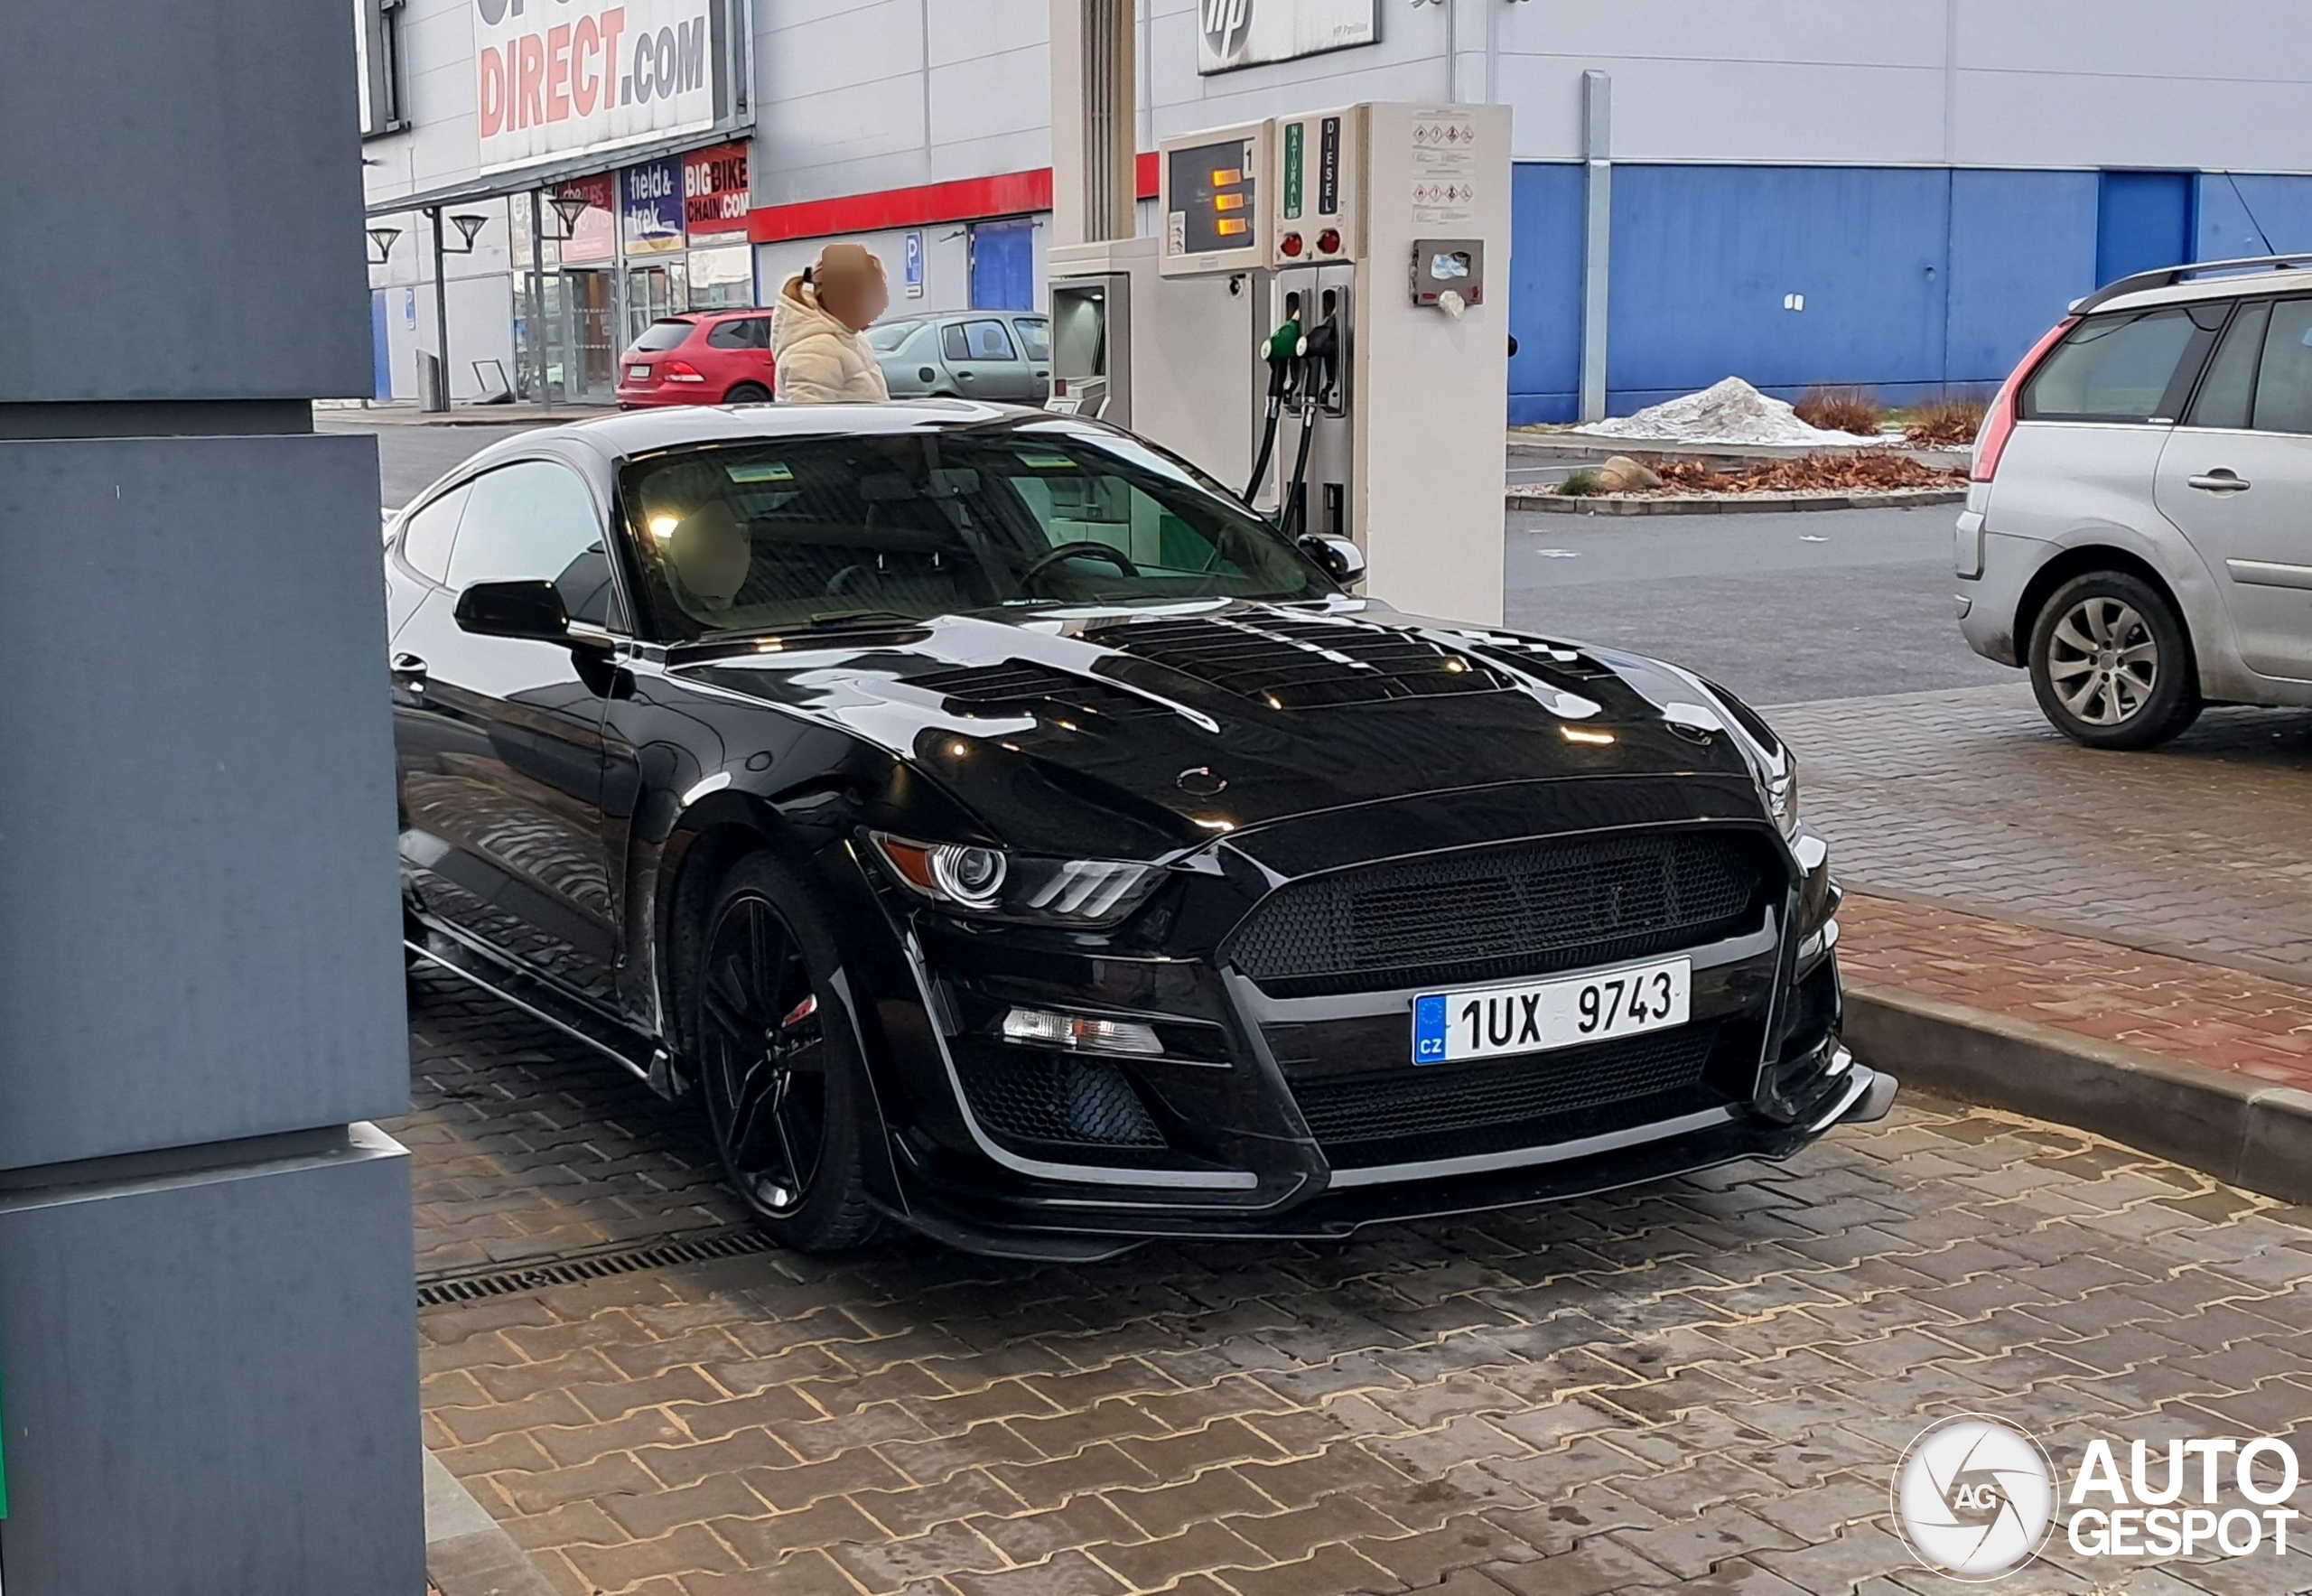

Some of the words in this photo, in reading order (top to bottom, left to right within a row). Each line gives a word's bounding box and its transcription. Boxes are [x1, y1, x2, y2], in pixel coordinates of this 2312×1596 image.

[480, 6, 704, 139] DIRECT.COM
[1245, 148, 1253, 172] 1
[1290, 125, 1299, 207] NATURAL
[1325, 120, 1335, 212] DIESEL
[631, 201, 661, 235] trek
[687, 191, 750, 223] CHAIN.COM
[908, 238, 918, 268] P
[1461, 993, 1542, 1050] 1UX
[1578, 971, 1673, 1034] 9743
[1420, 1038, 1442, 1054] CZ
